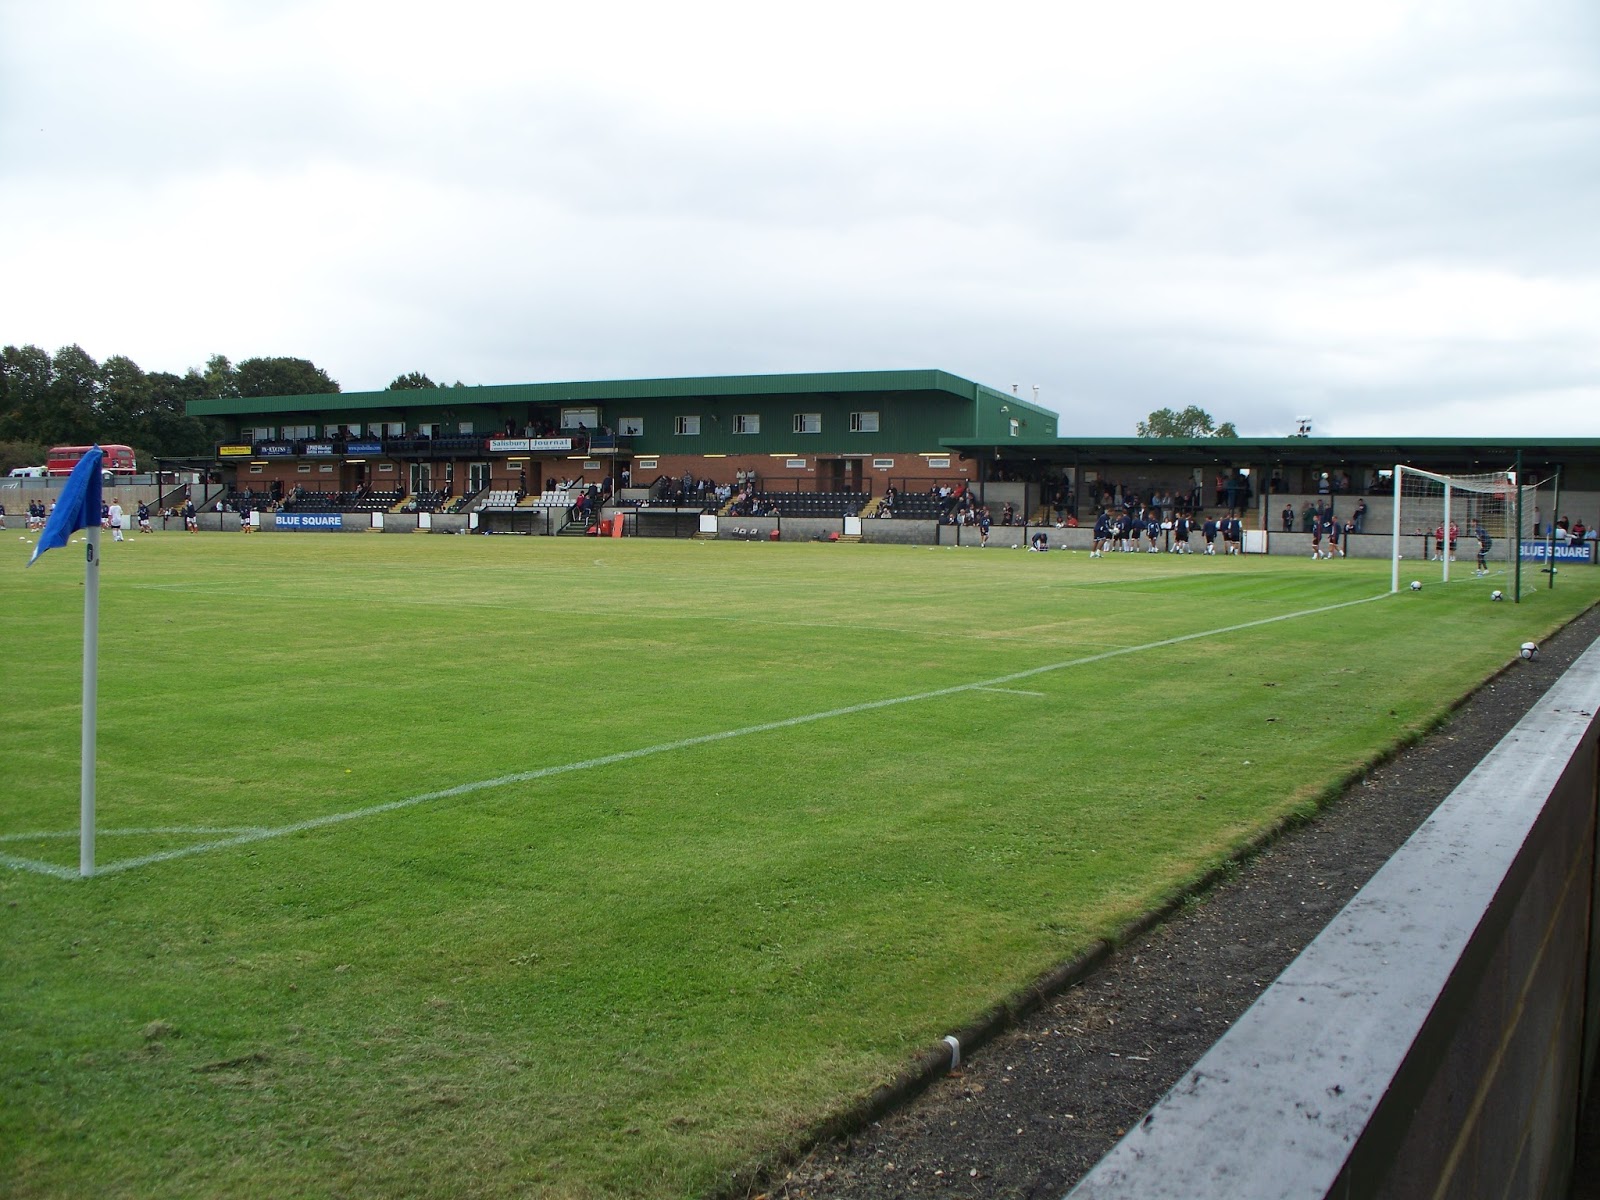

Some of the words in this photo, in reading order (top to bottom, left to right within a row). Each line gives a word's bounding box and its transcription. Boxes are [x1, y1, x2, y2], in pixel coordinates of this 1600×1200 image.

[276, 517, 299, 525] BLUE
[302, 517, 341, 525] SQUARE
[1519, 545, 1544, 556] BLUE
[1546, 546, 1589, 557] SQUARE
